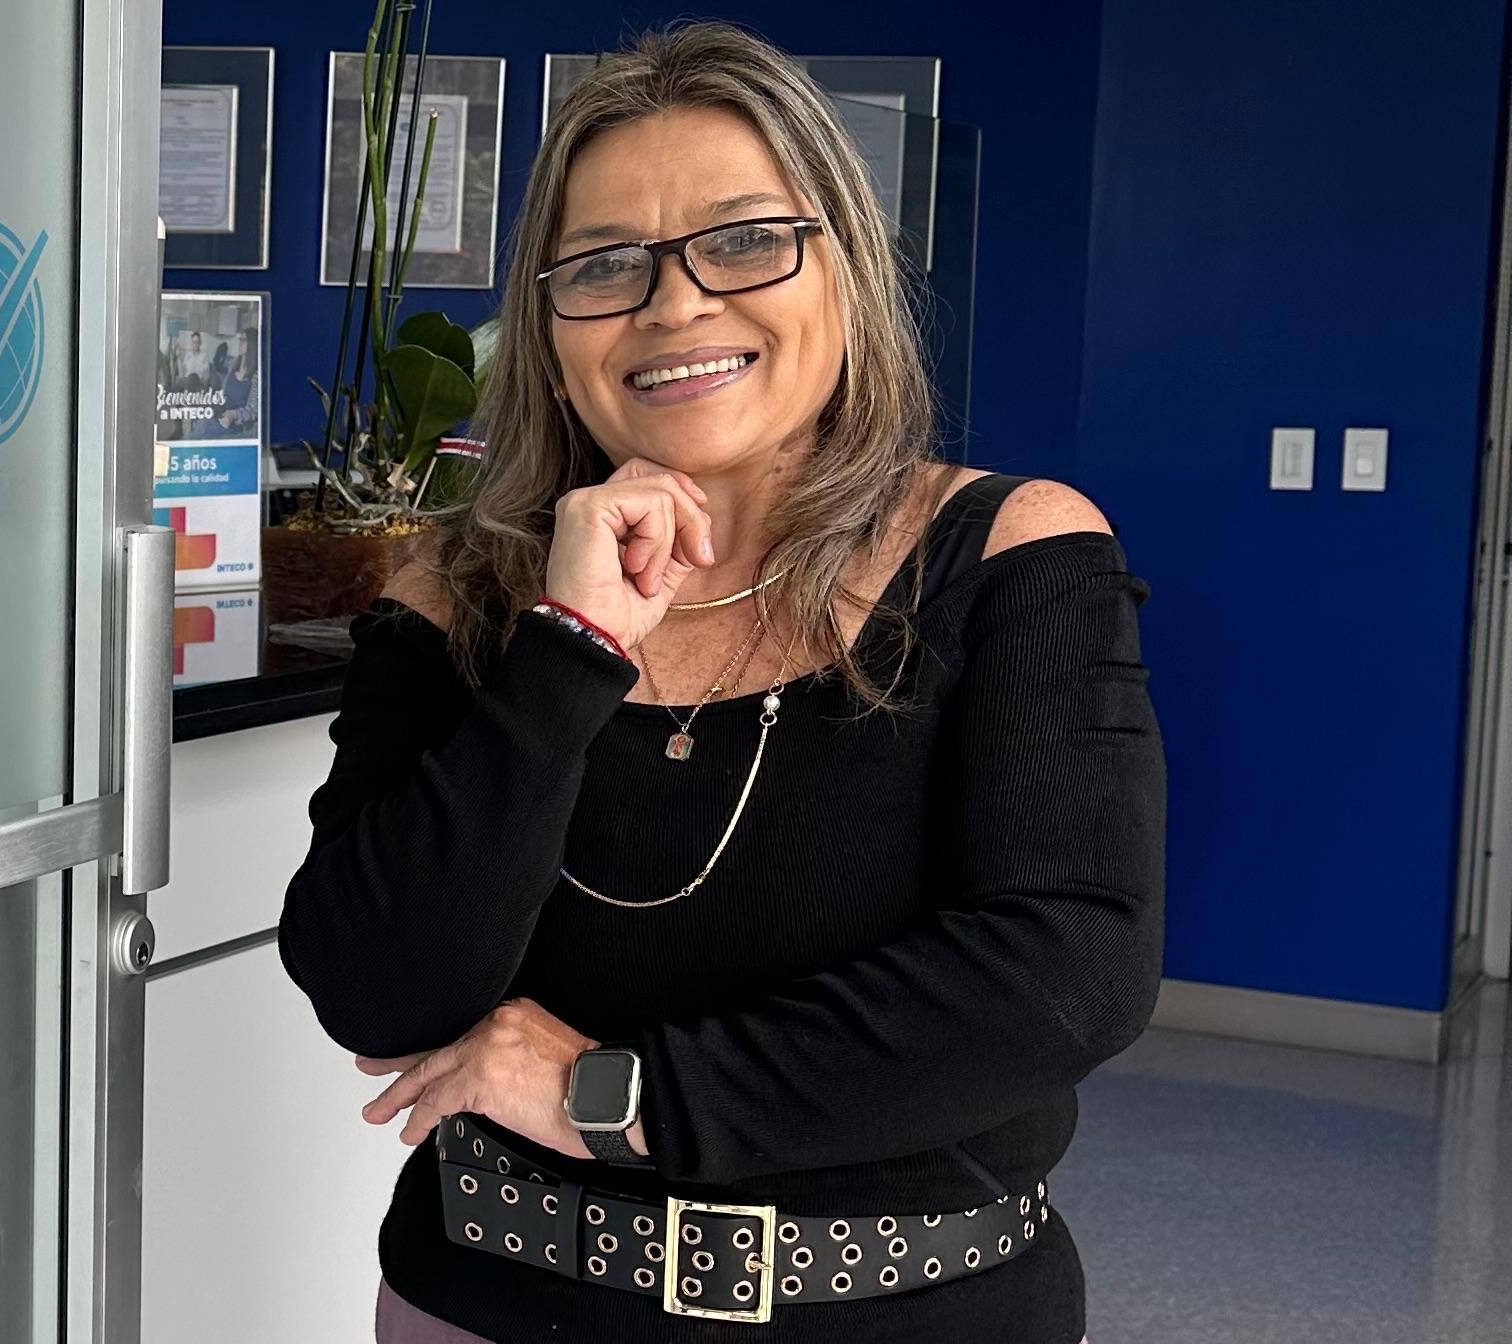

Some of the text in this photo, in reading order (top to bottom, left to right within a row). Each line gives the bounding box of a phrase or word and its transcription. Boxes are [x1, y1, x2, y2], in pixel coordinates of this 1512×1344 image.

[160, 407, 214, 420] a INTECO
[183, 454, 217, 471] años
[217, 563, 246, 572] INTECO
